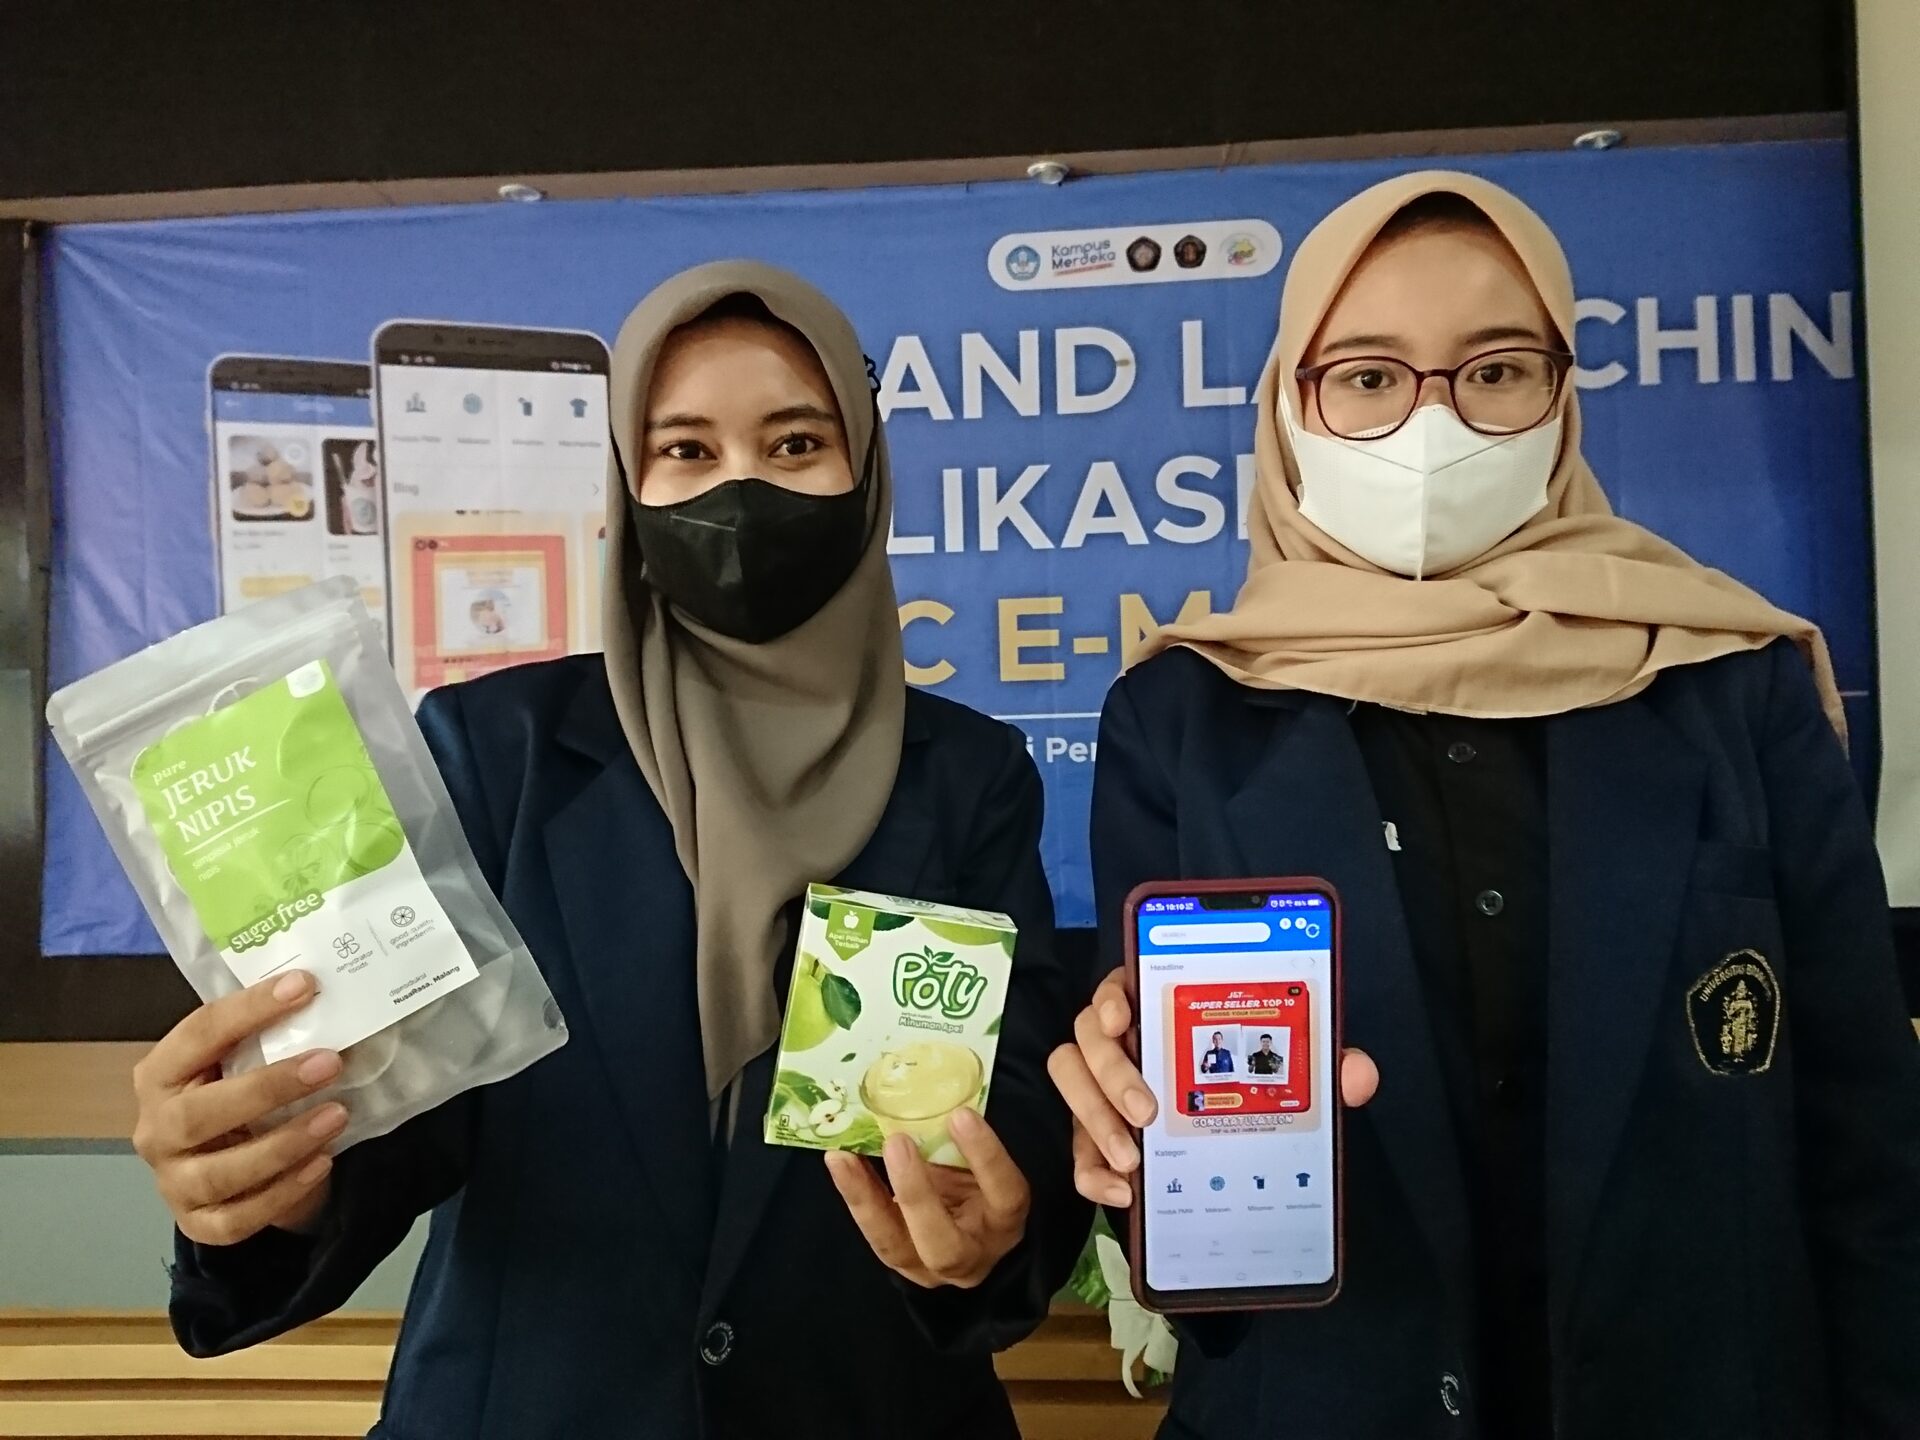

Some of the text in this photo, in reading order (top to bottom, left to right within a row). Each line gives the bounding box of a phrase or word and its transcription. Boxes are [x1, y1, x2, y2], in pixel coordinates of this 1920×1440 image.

[1051, 240, 1111, 258] Kampus
[1051, 251, 1116, 271] Merdeka
[1182, 320, 1279, 407] L
[152, 760, 187, 786] pure
[161, 746, 257, 820] JERUK
[176, 784, 257, 843] NIPIS
[231, 892, 320, 950] sugar free
[432, 965, 461, 983] Malang
[1188, 998, 1296, 1010] SUPER SELLER TOP 10
[899, 1016, 964, 1034] Minuman Apel
